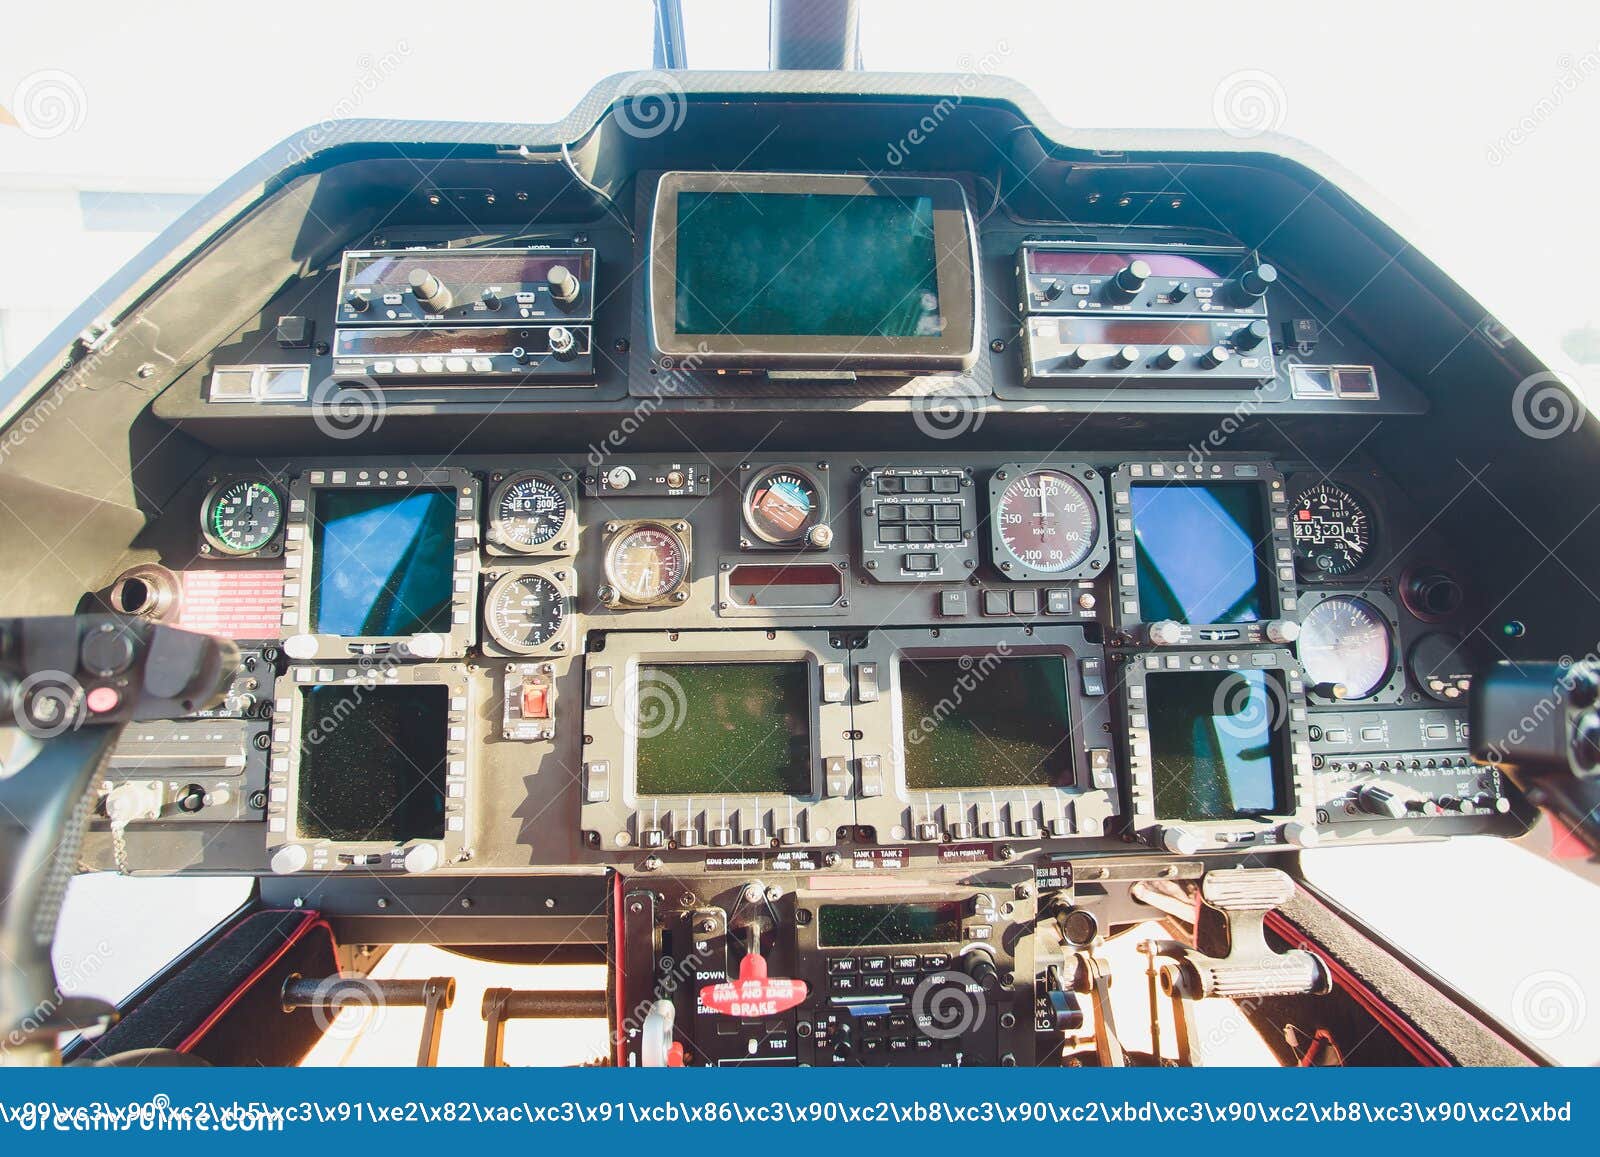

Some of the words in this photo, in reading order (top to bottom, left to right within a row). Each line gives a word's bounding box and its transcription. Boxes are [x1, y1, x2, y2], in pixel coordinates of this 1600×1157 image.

[1023, 487, 1041, 498] 200
[1046, 486, 1058, 496] 20
[1063, 503, 1077, 513] 40
[1005, 513, 1022, 524] 150
[1066, 531, 1079, 541] 60
[1025, 550, 1042, 560] 100
[1050, 550, 1063, 560] 80
[839, 960, 852, 969] NAV
[870, 960, 884, 968] WPT
[900, 958, 916, 968] NRST
[696, 971, 725, 980] DOWN
[931, 976, 946, 985] MSG
[840, 979, 852, 988] FPL
[869, 978, 884, 987] CALC
[901, 976, 915, 986] AUX
[730, 1001, 777, 1017] BRAKE
[769, 1040, 787, 1048] TEST
